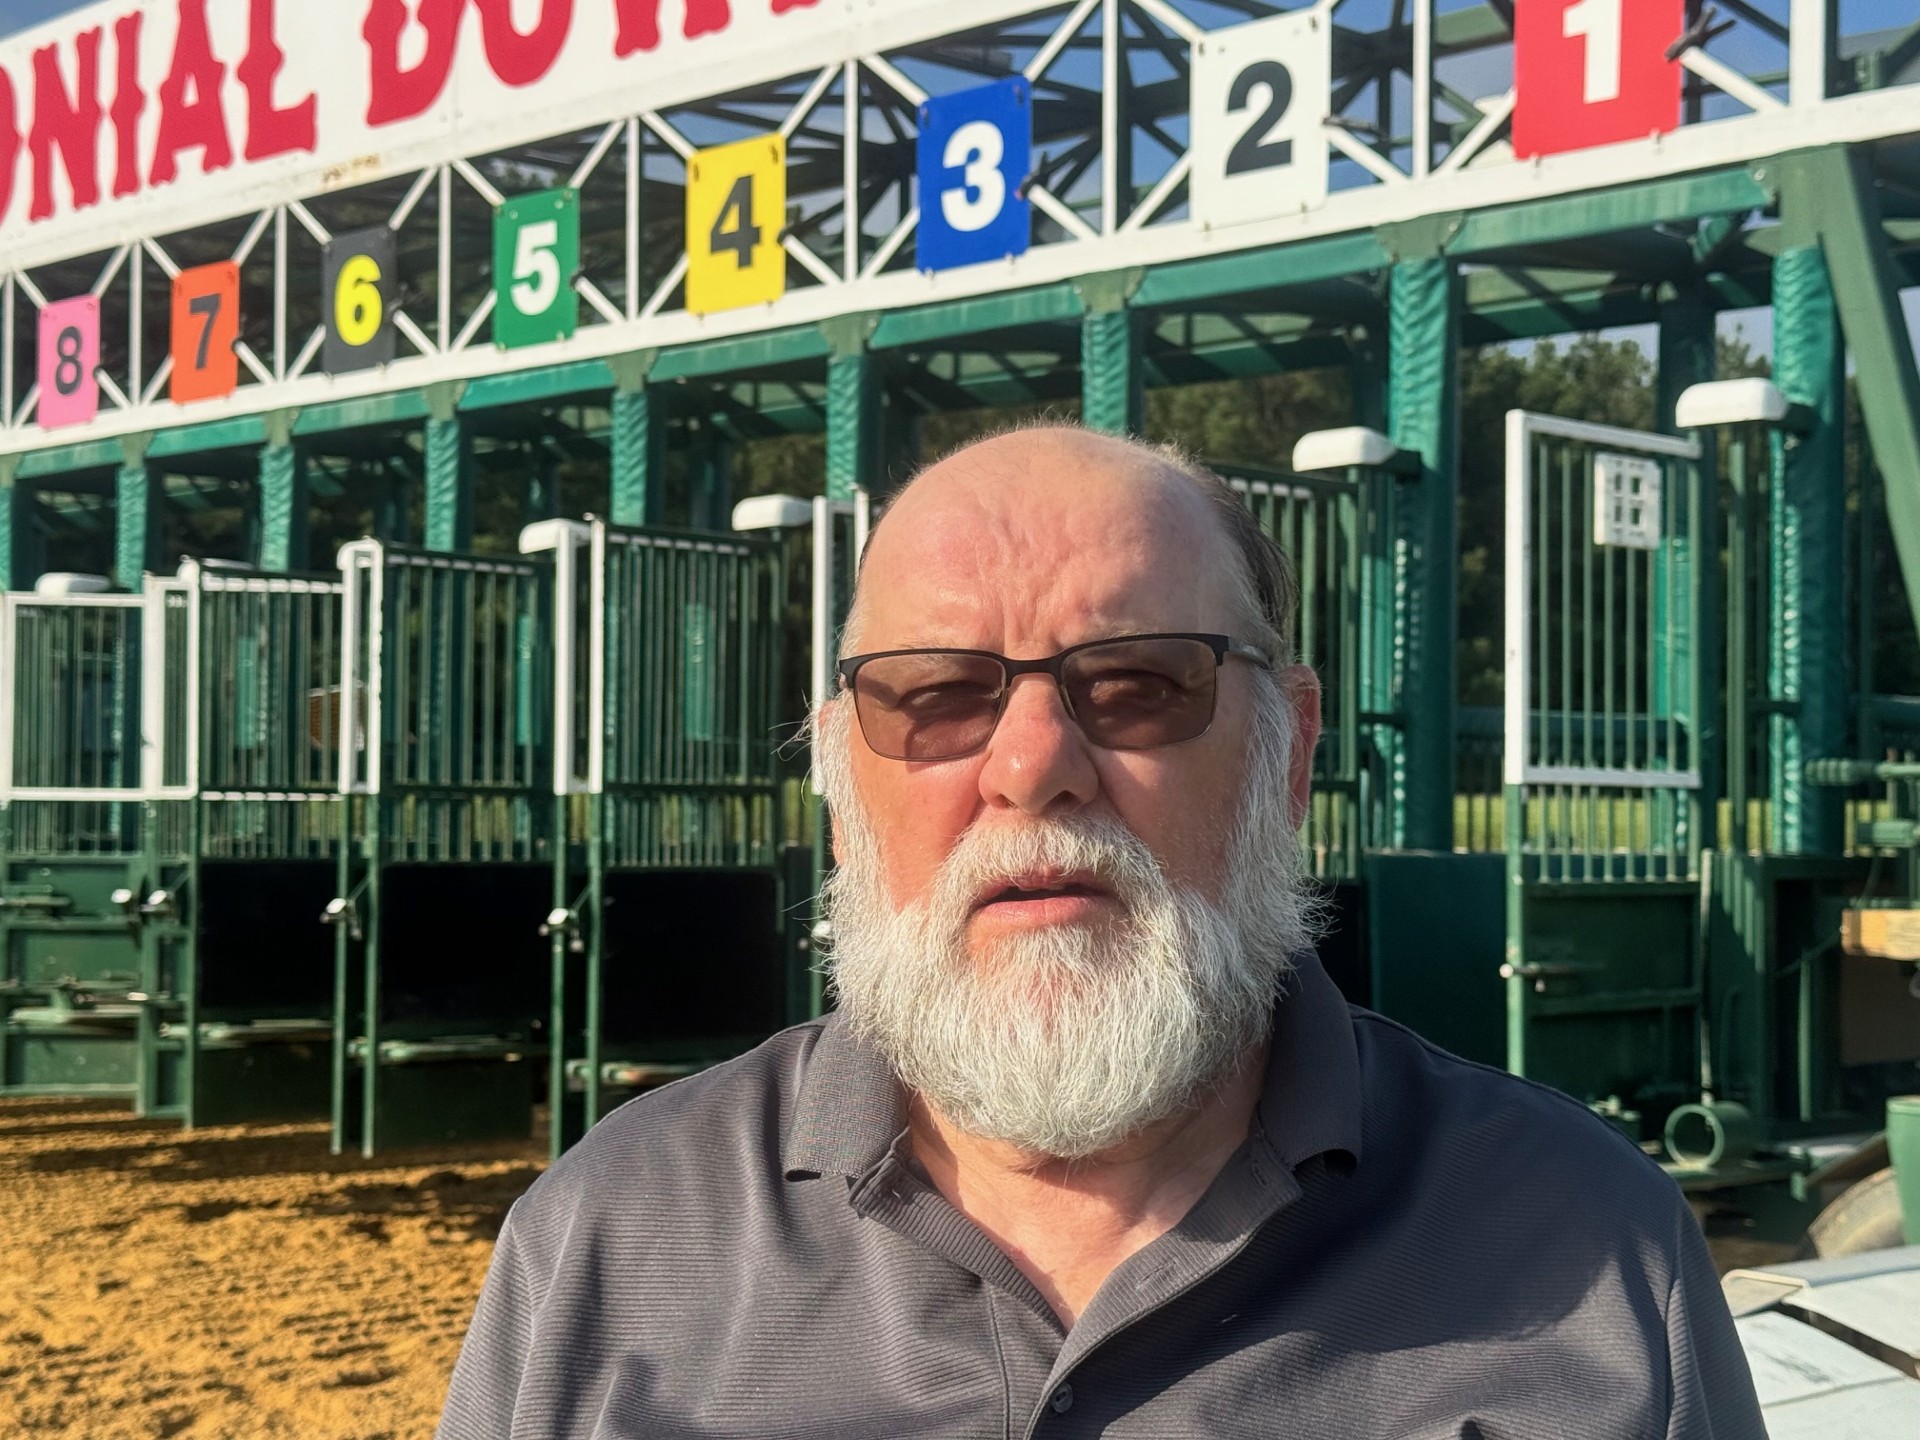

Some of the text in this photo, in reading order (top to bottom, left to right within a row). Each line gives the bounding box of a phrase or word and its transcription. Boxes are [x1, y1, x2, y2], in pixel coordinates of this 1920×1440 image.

[1562, 0, 1622, 104] 1
[1225, 60, 1293, 177] 2
[709, 174, 763, 271] 4
[941, 121, 1005, 232] 3
[334, 255, 383, 346] 6
[511, 221, 561, 316] 5
[55, 326, 83, 395] 8
[189, 293, 222, 371] 7
